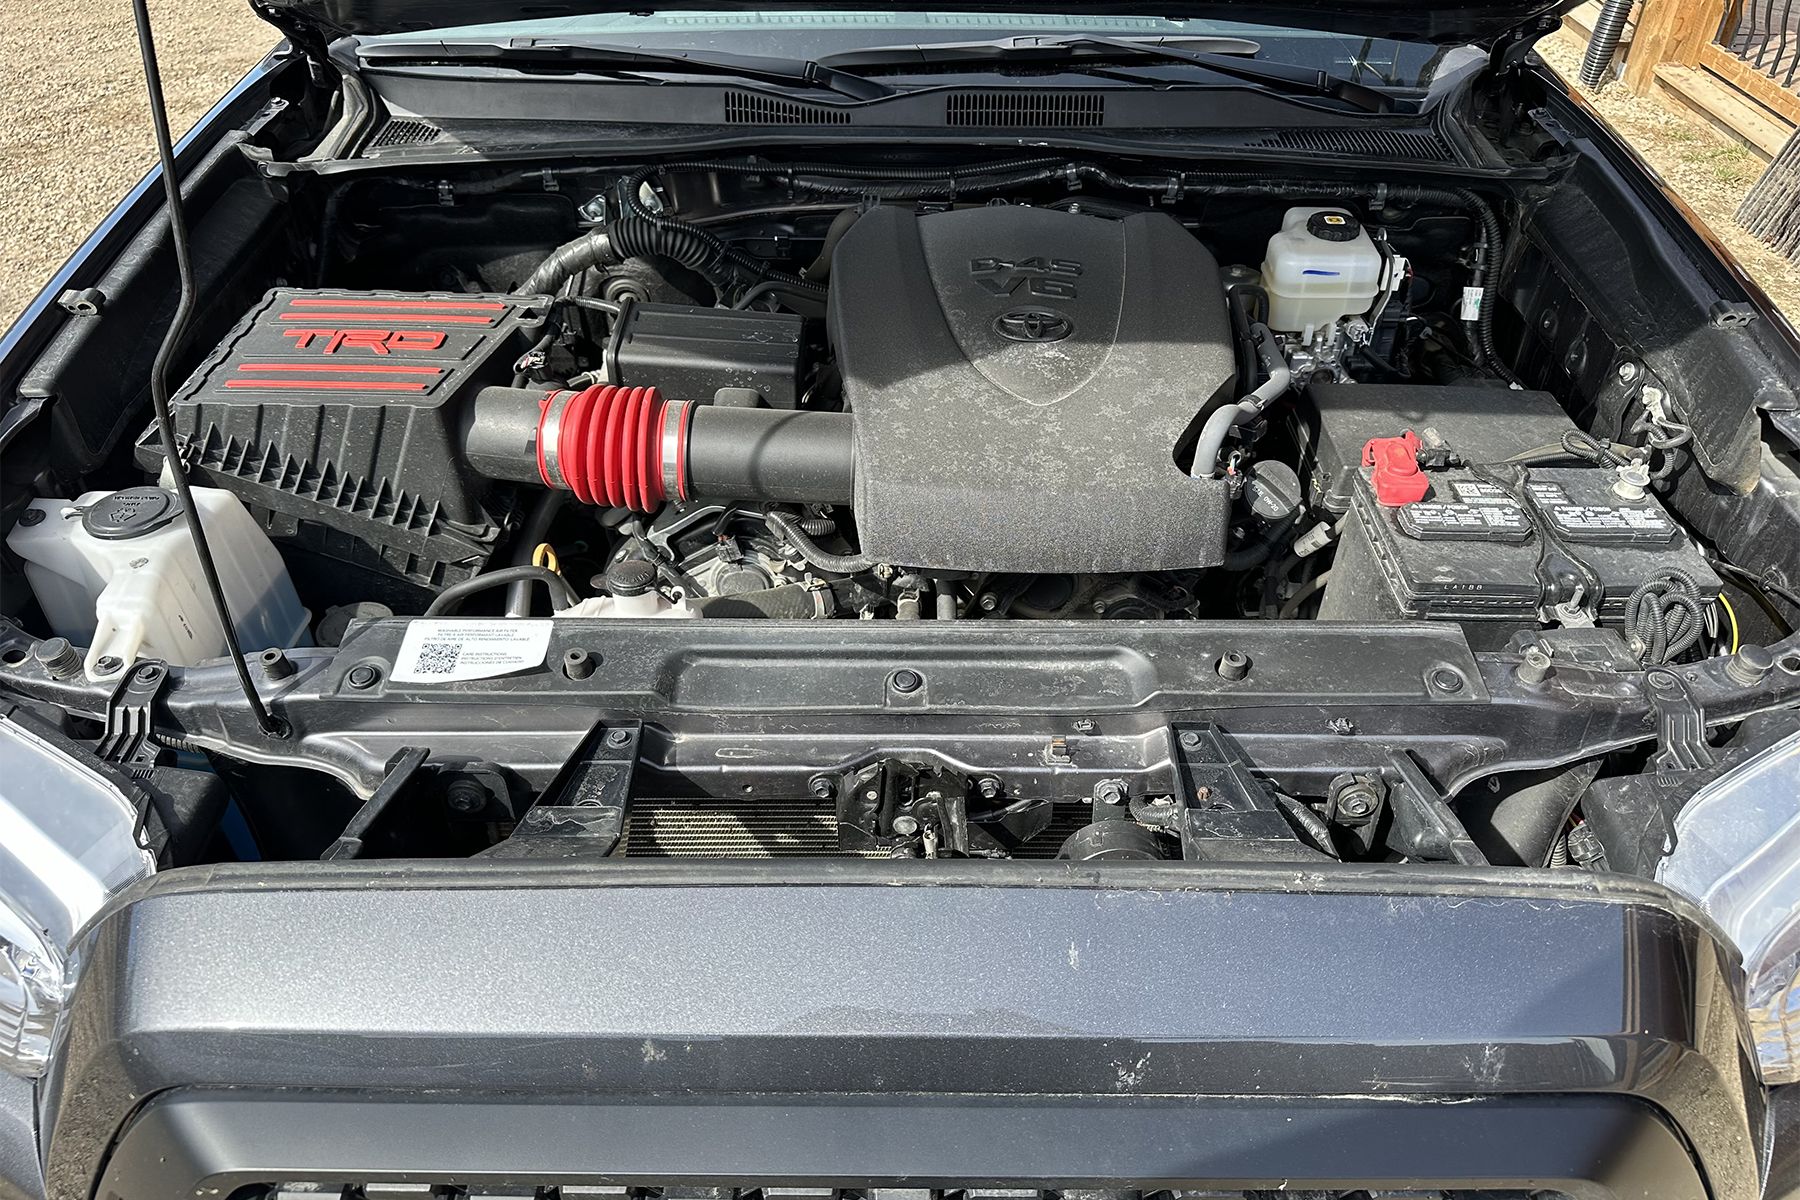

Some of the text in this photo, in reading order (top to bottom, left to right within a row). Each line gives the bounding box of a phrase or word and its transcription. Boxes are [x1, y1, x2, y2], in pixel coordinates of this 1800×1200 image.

[974, 277, 1077, 299] V6
[283, 329, 447, 354] TRD
[1263, 496, 1279, 512] 0W-20
